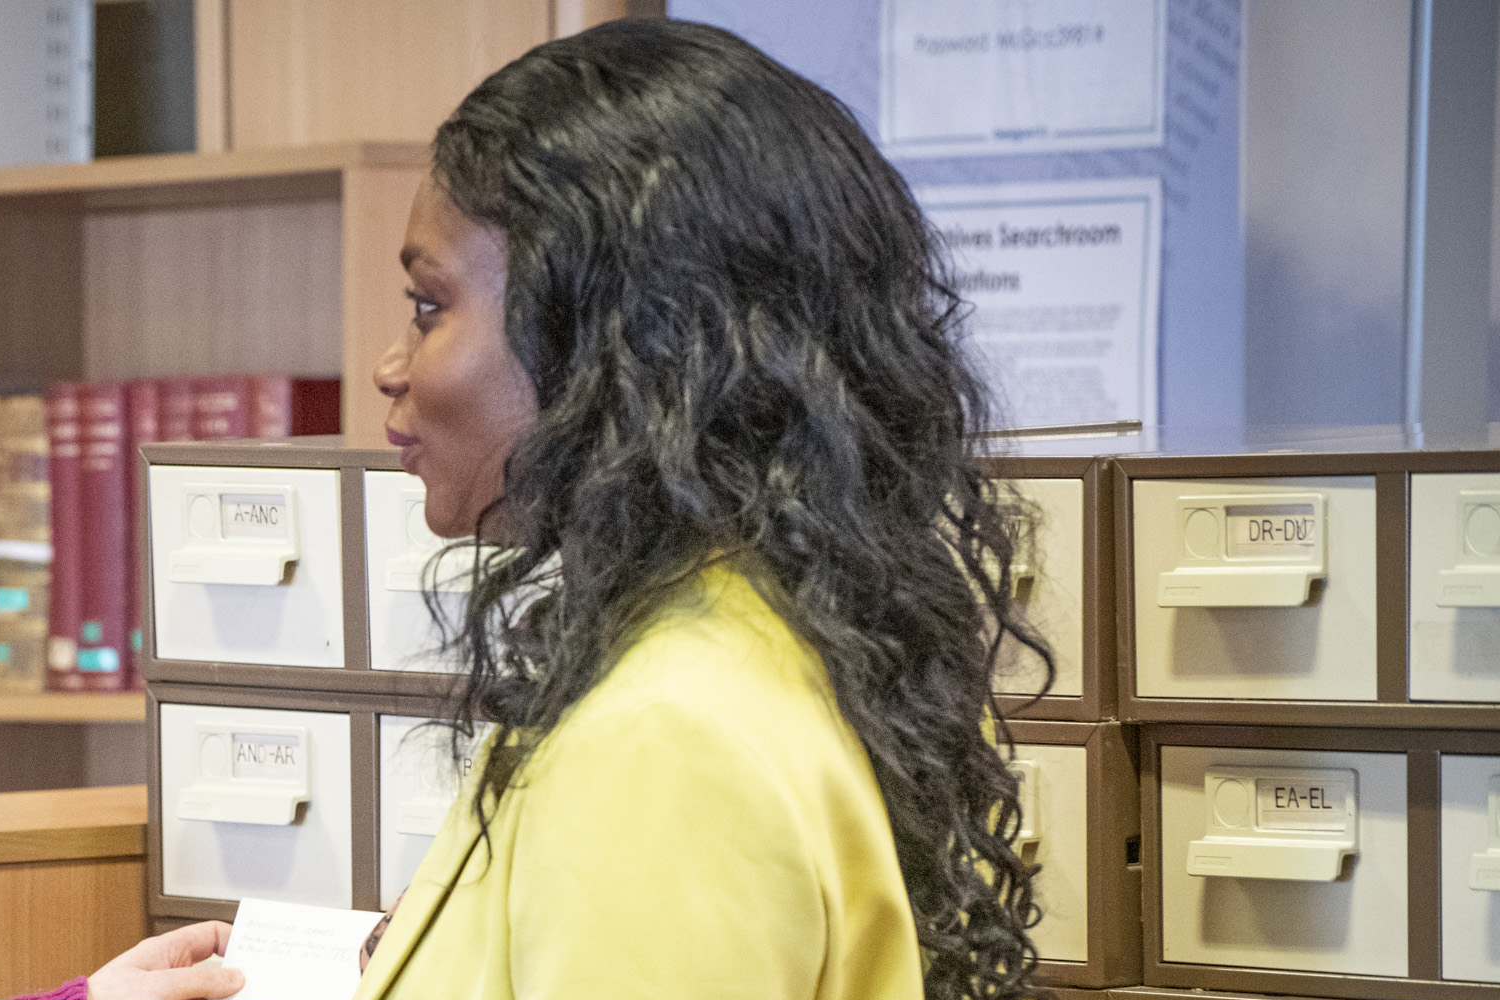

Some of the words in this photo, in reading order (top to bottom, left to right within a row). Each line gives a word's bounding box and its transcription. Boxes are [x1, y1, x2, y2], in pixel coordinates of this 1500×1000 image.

[234, 503, 278, 526] A-ANC
[237, 743, 295, 765] AND-AR
[1275, 786, 1332, 810] EA-EL
